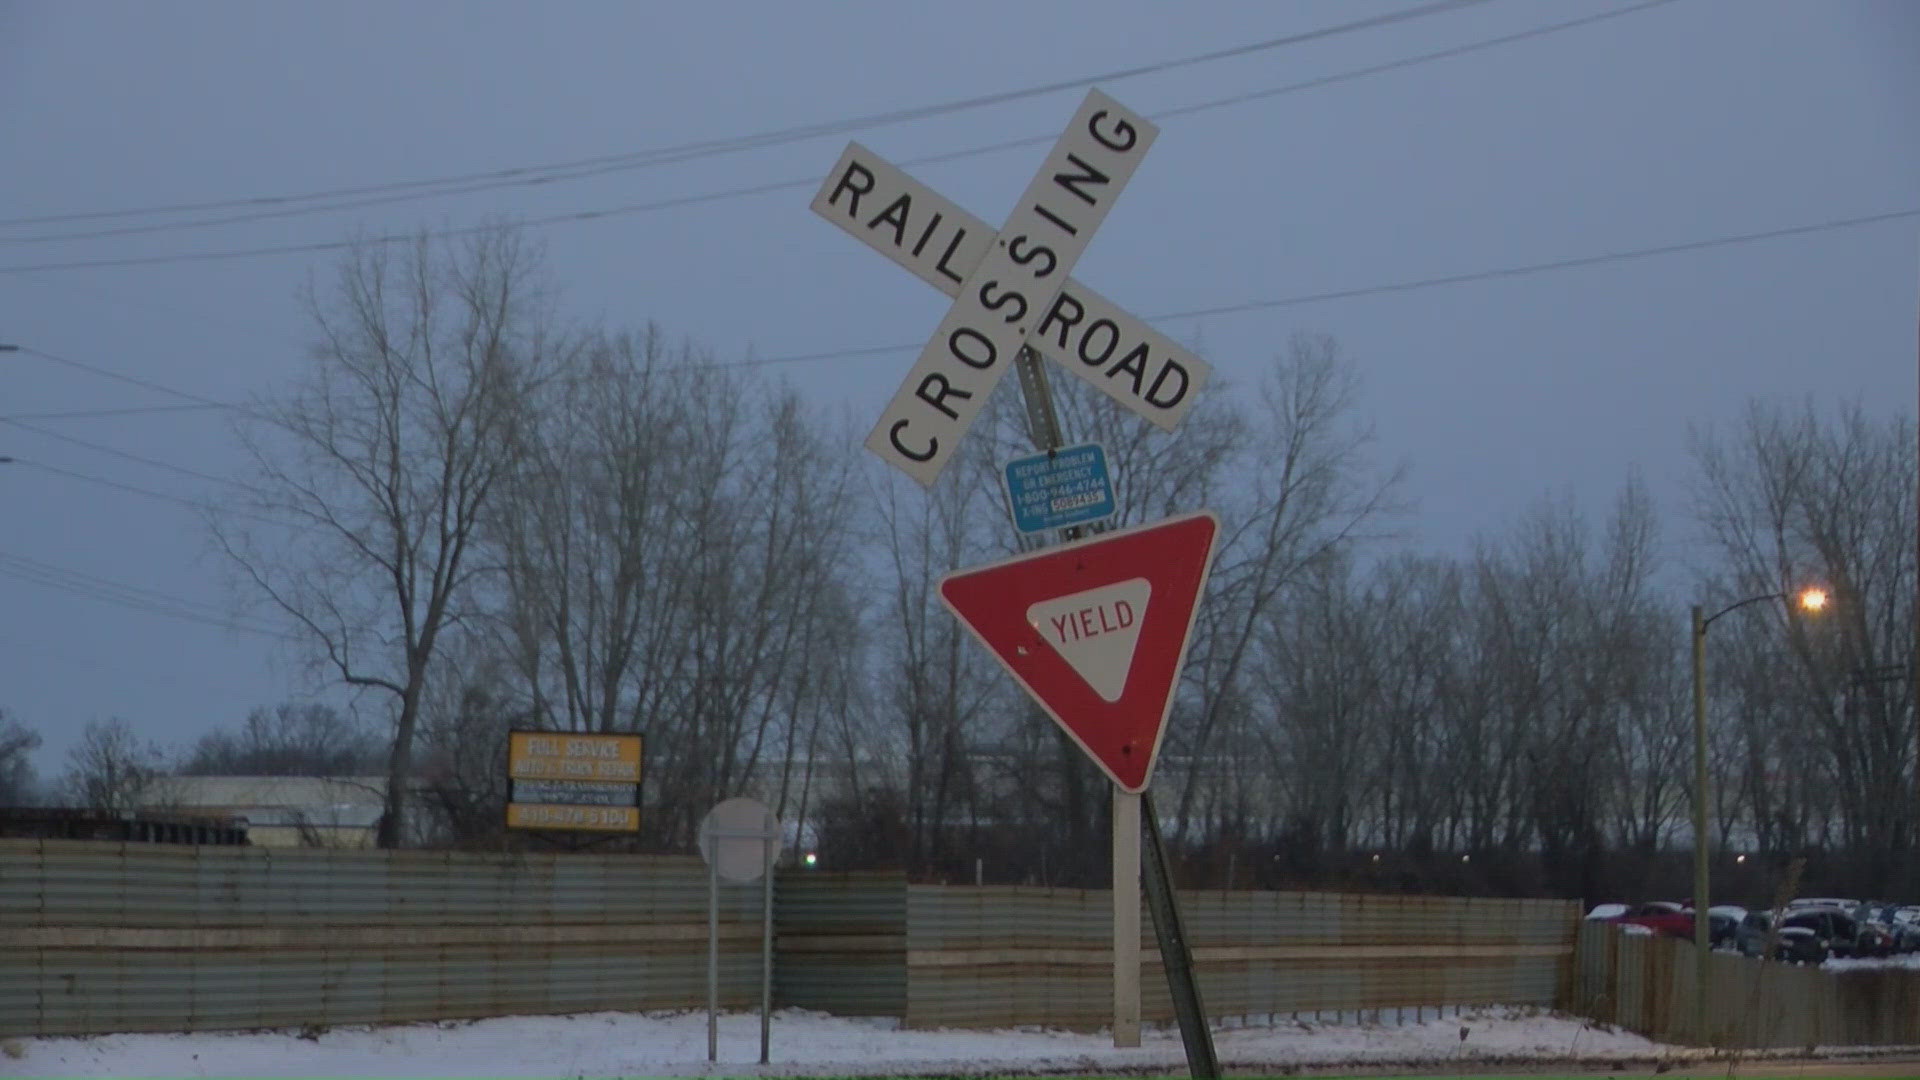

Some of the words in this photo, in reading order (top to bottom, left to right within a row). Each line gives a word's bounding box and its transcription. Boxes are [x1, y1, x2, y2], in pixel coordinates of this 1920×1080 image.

[828, 160, 967, 285] RAIL
[1037, 292, 1190, 410] ROAD
[889, 110, 1137, 463] CROSSING
[1015, 461, 1051, 478] REPORT
[1052, 452, 1096, 471] PROBLEM
[1038, 466, 1092, 487] EMERGENCY
[1050, 600, 1134, 643] YIELD
[527, 737, 559, 756] FULL
[565, 739, 620, 758] SERVICE
